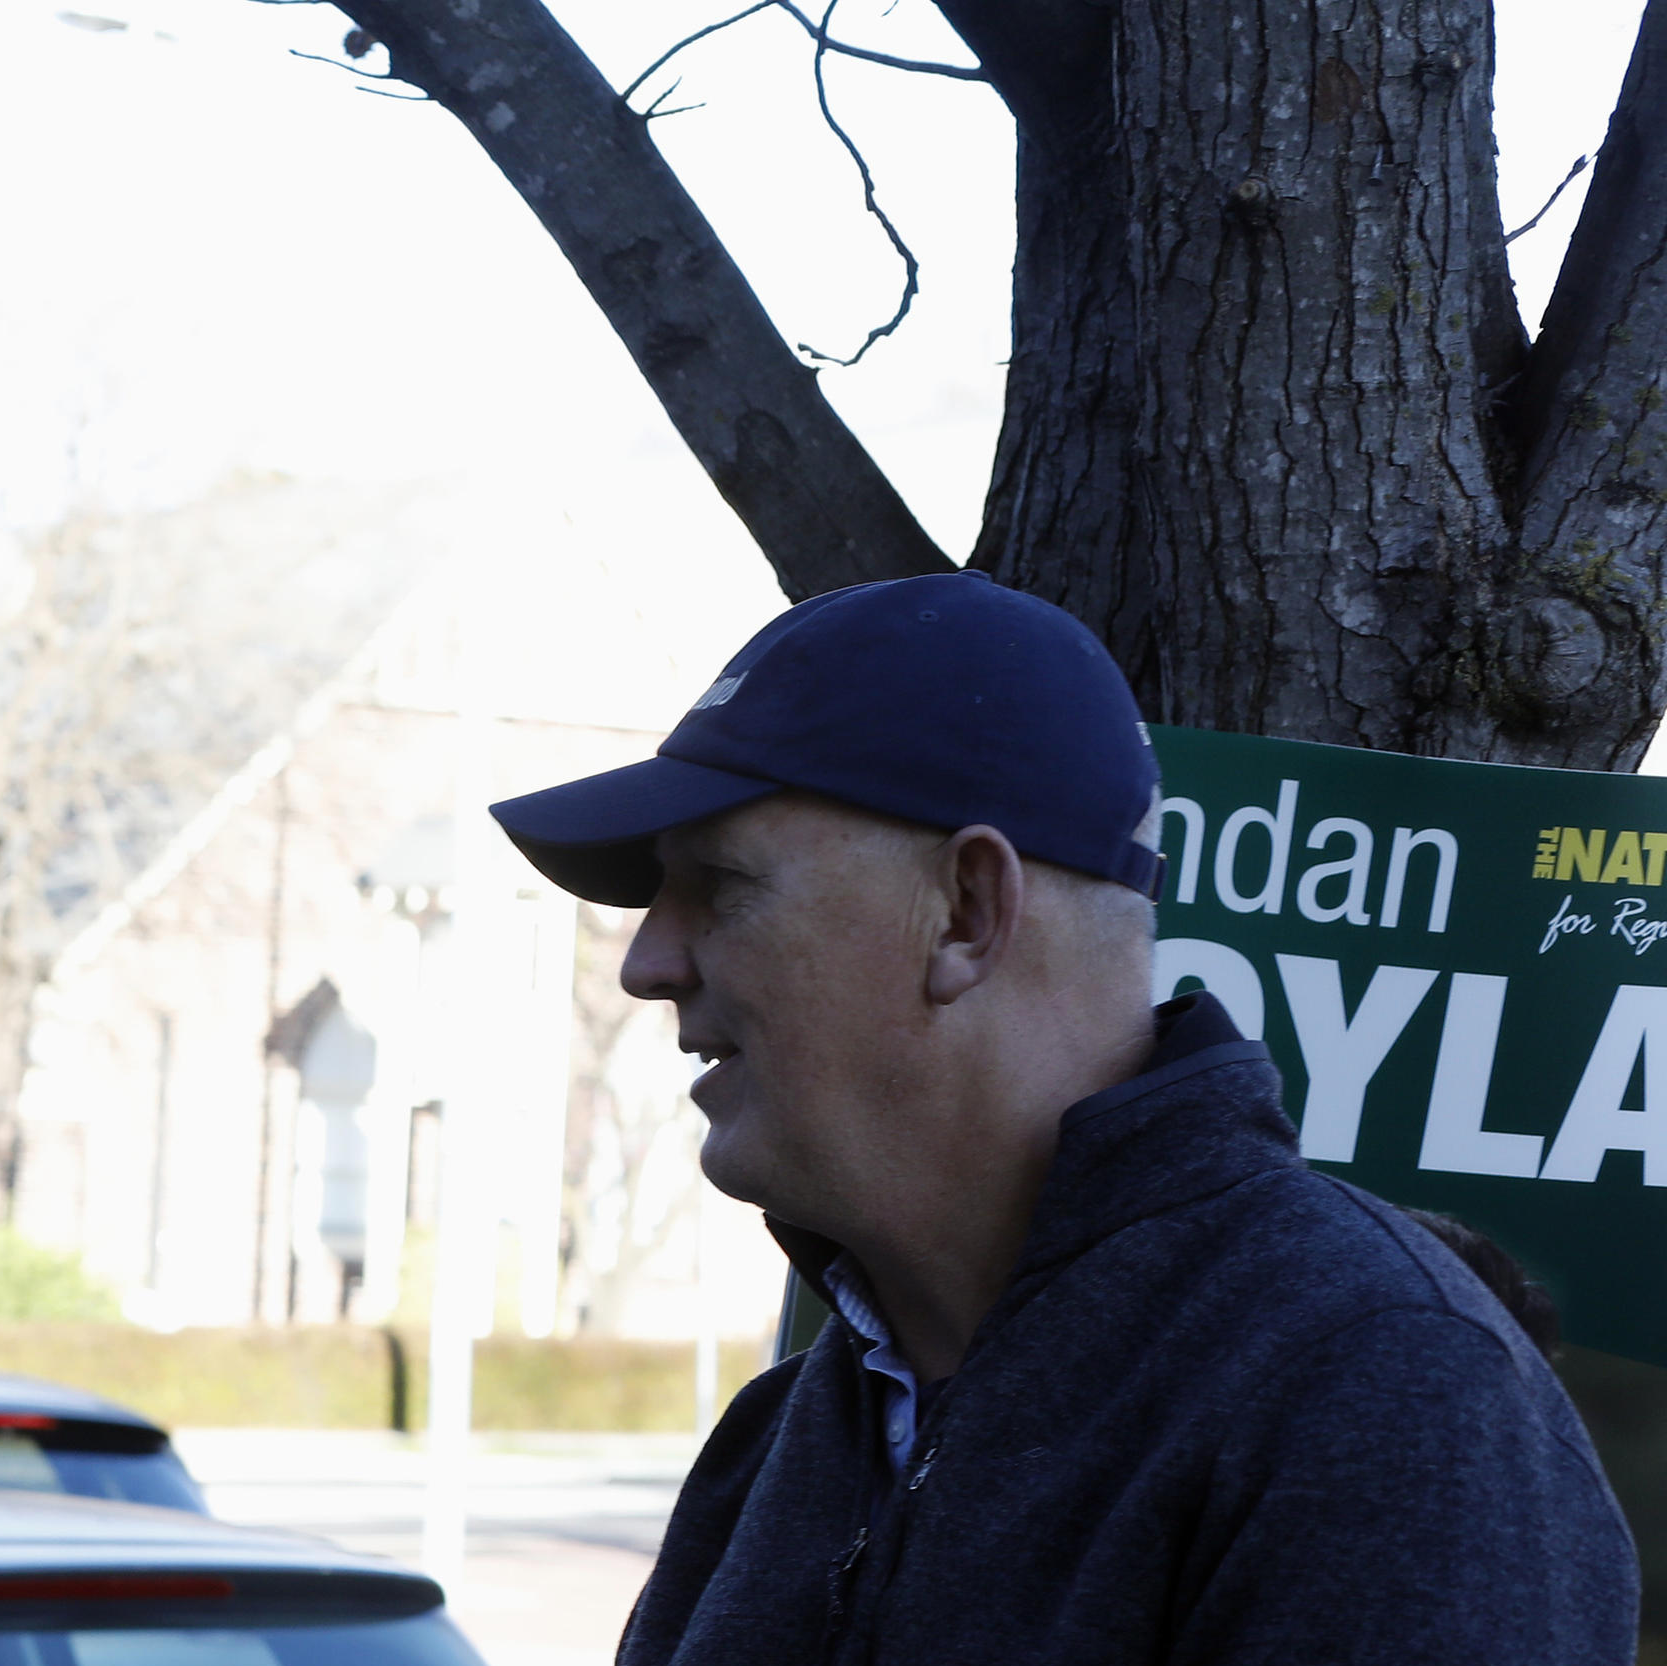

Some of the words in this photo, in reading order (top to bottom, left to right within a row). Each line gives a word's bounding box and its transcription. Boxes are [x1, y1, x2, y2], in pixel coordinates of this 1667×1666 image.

[1162, 778, 1459, 934] ndan
[1532, 826, 1561, 880] THE
[1555, 826, 1667, 887] NAT
[1539, 894, 1597, 955] for
